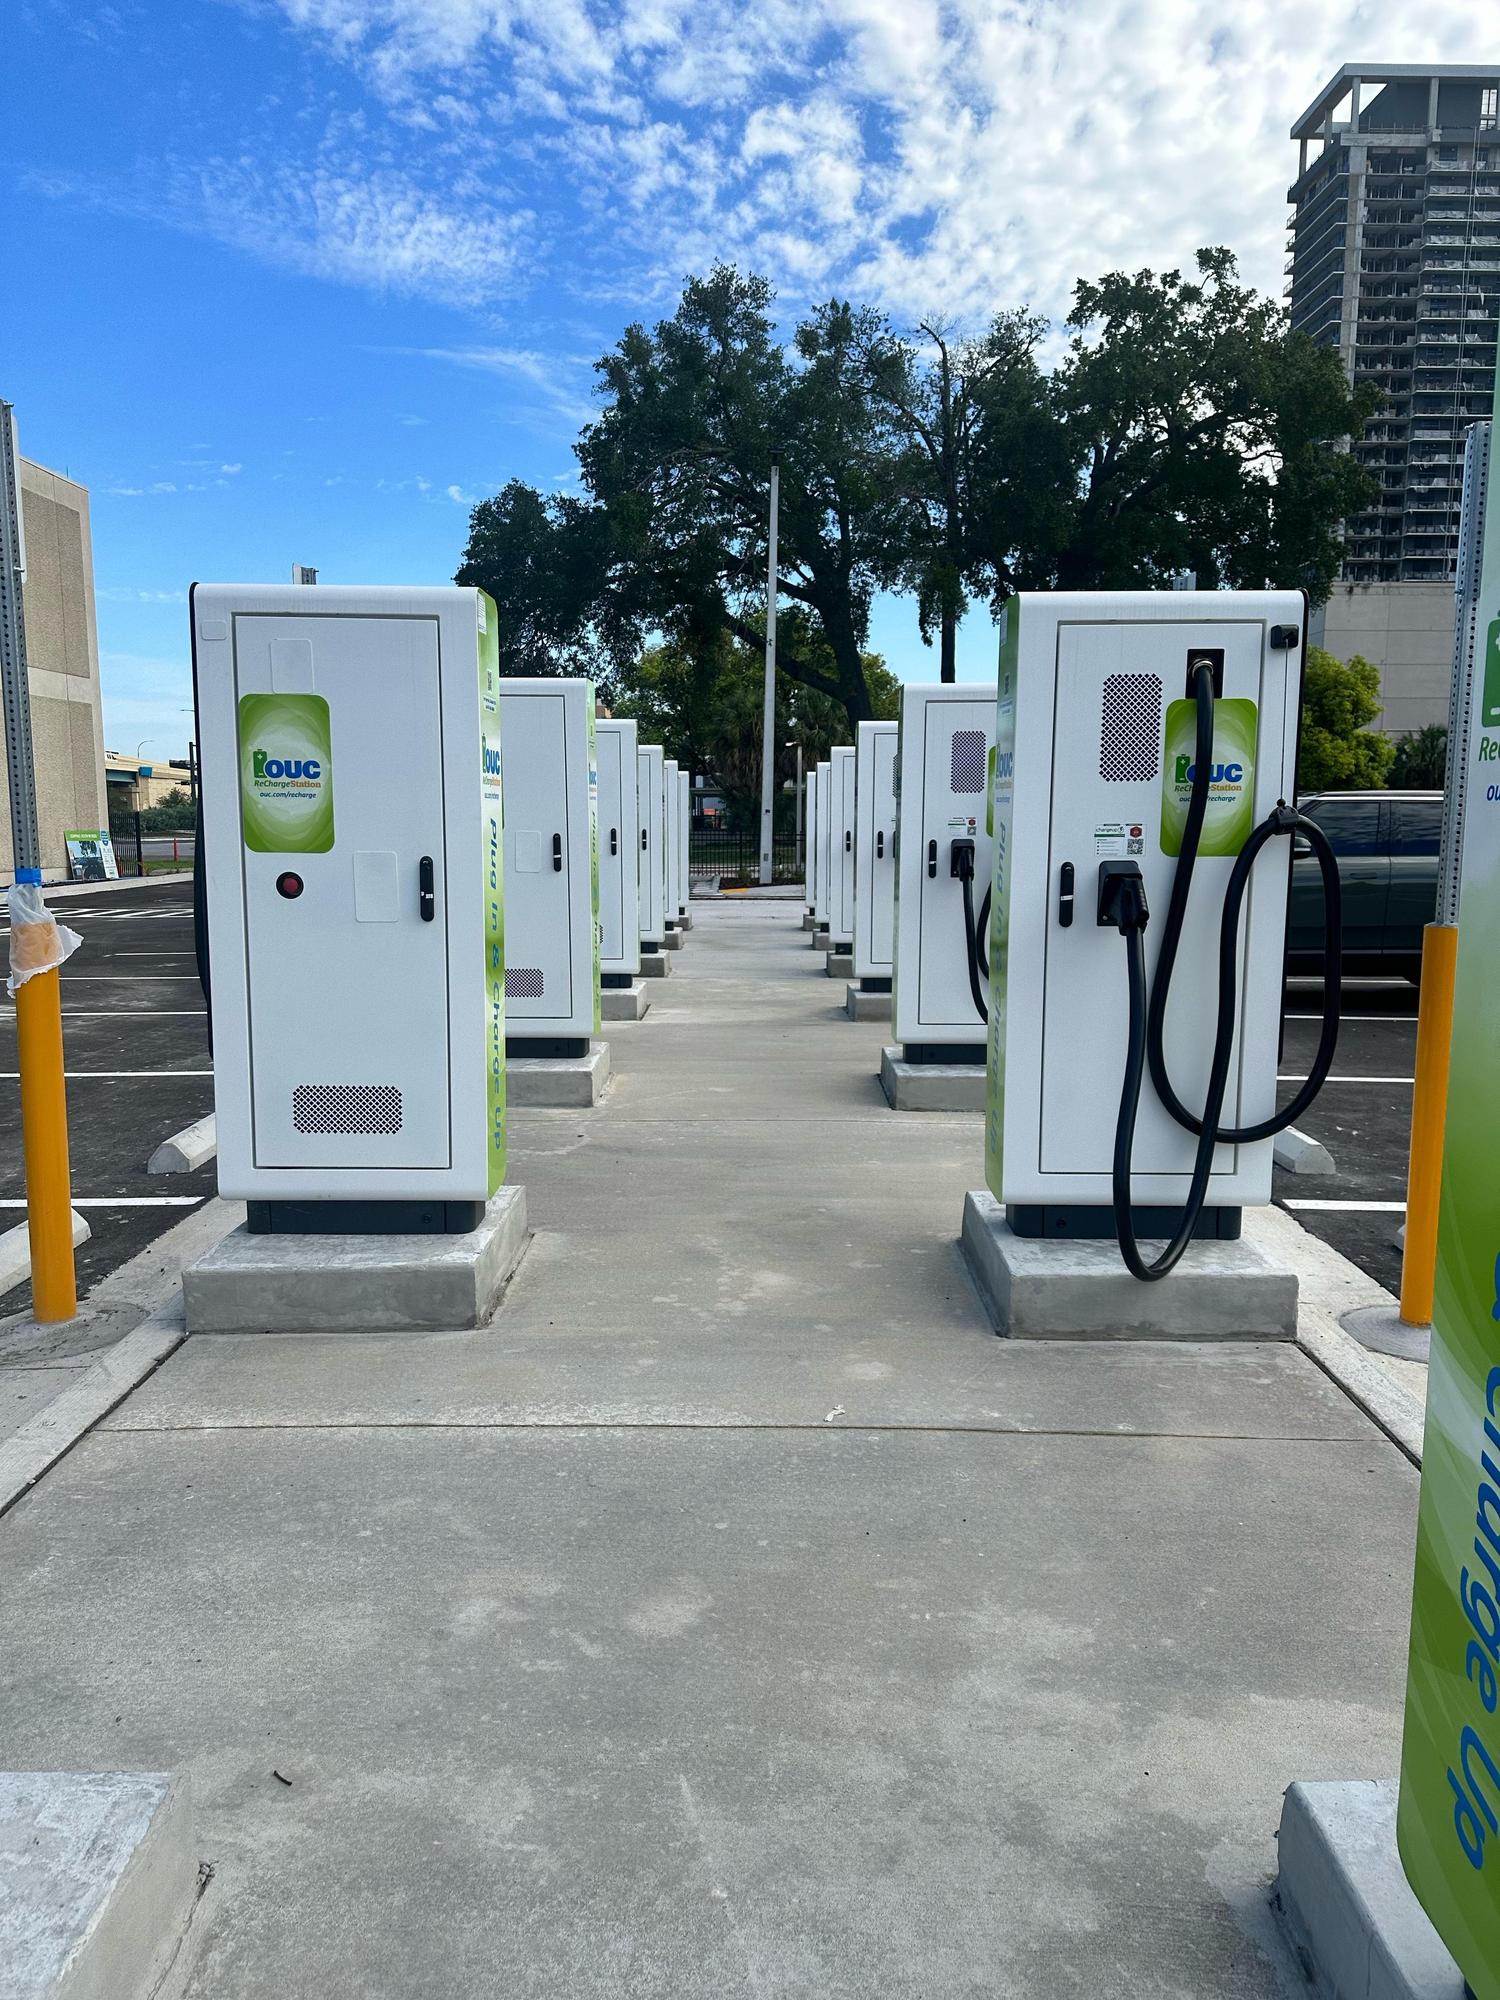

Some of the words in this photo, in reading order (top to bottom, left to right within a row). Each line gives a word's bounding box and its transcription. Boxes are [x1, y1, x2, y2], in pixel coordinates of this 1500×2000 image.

[1479, 736, 1500, 762] Re
[254, 779, 321, 789] ReChargeStation
[264, 759, 321, 780] OUC
[259, 791, 317, 800] ouc.com/recharge
[1174, 784, 1242, 793] ReCStation
[490, 818, 498, 891] Plug
[996, 820, 1006, 896] Plug
[492, 981, 501, 1095] Charge
[494, 1106, 502, 1150] Up
[1447, 1724, 1500, 1870] Up
